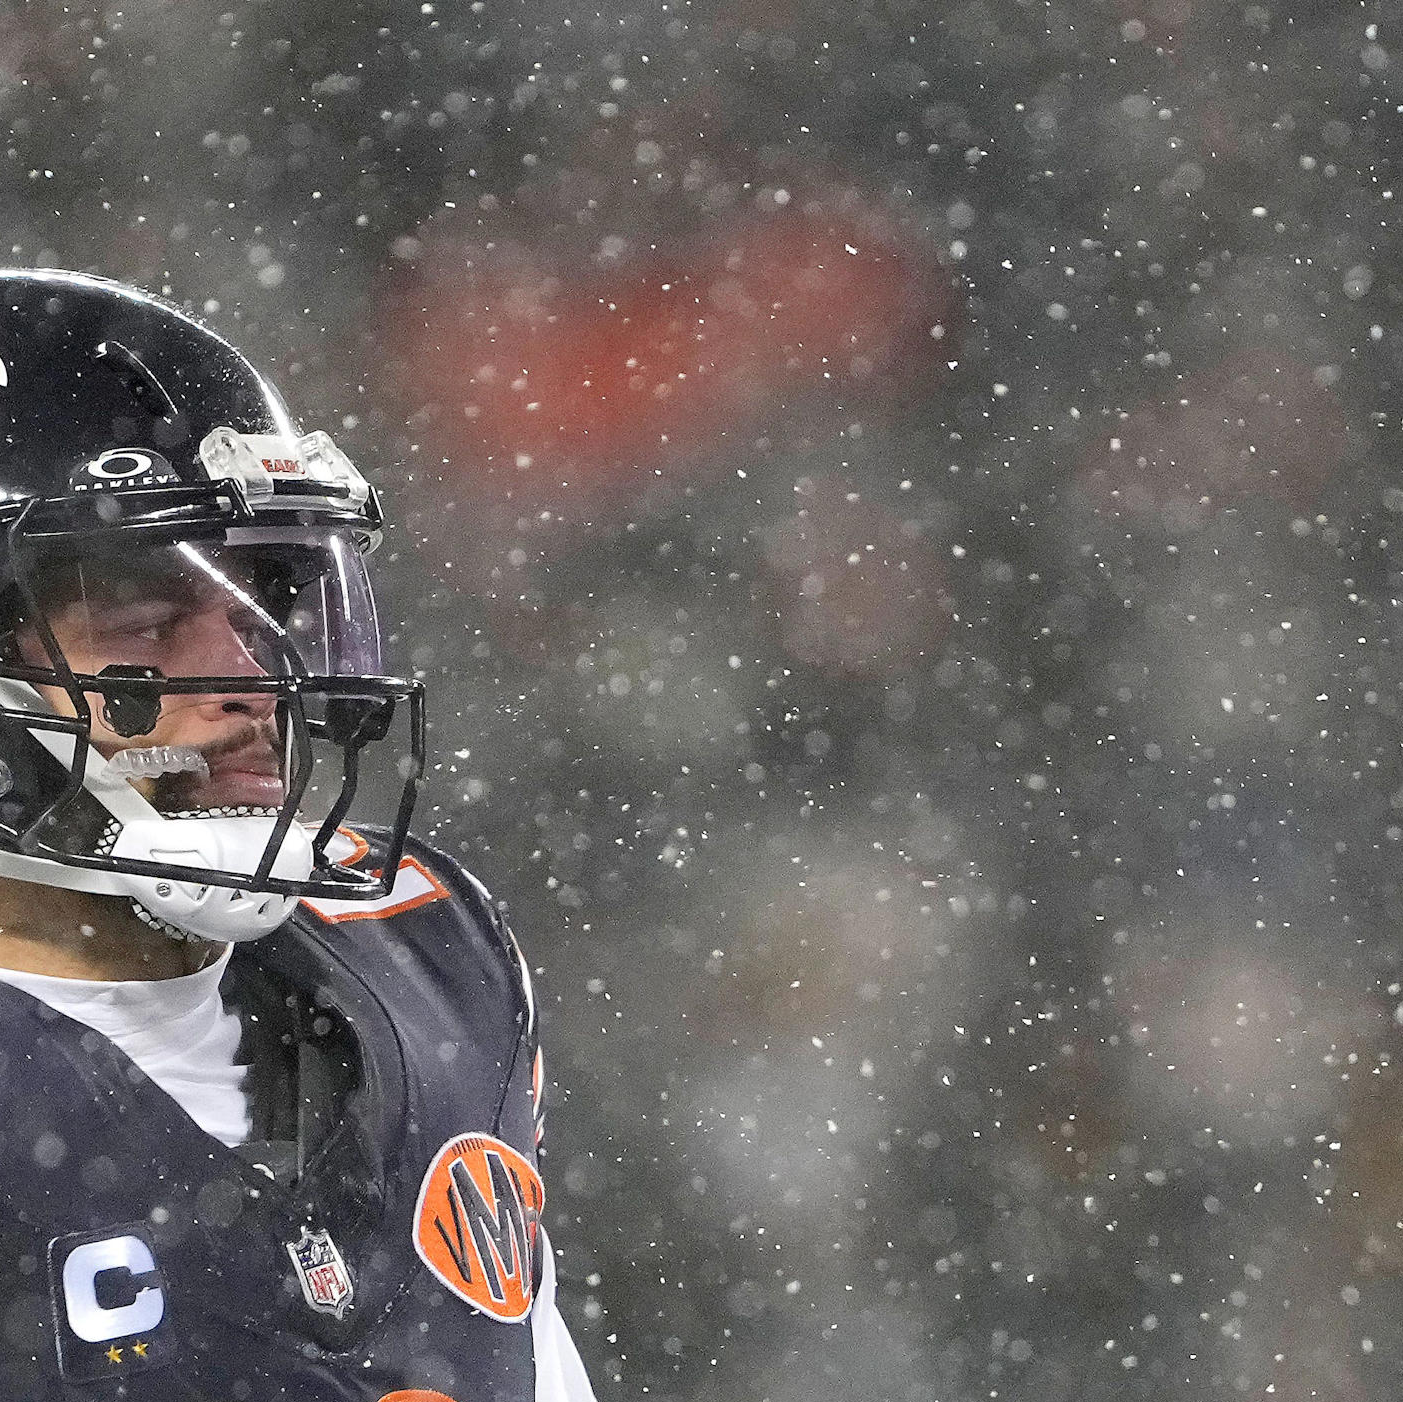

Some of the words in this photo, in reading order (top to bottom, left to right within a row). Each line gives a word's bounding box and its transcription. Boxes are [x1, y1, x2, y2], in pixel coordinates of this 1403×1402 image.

[261, 458, 307, 475] EARS
[63, 1235, 166, 1343] C
[309, 1266, 347, 1301] NFL
